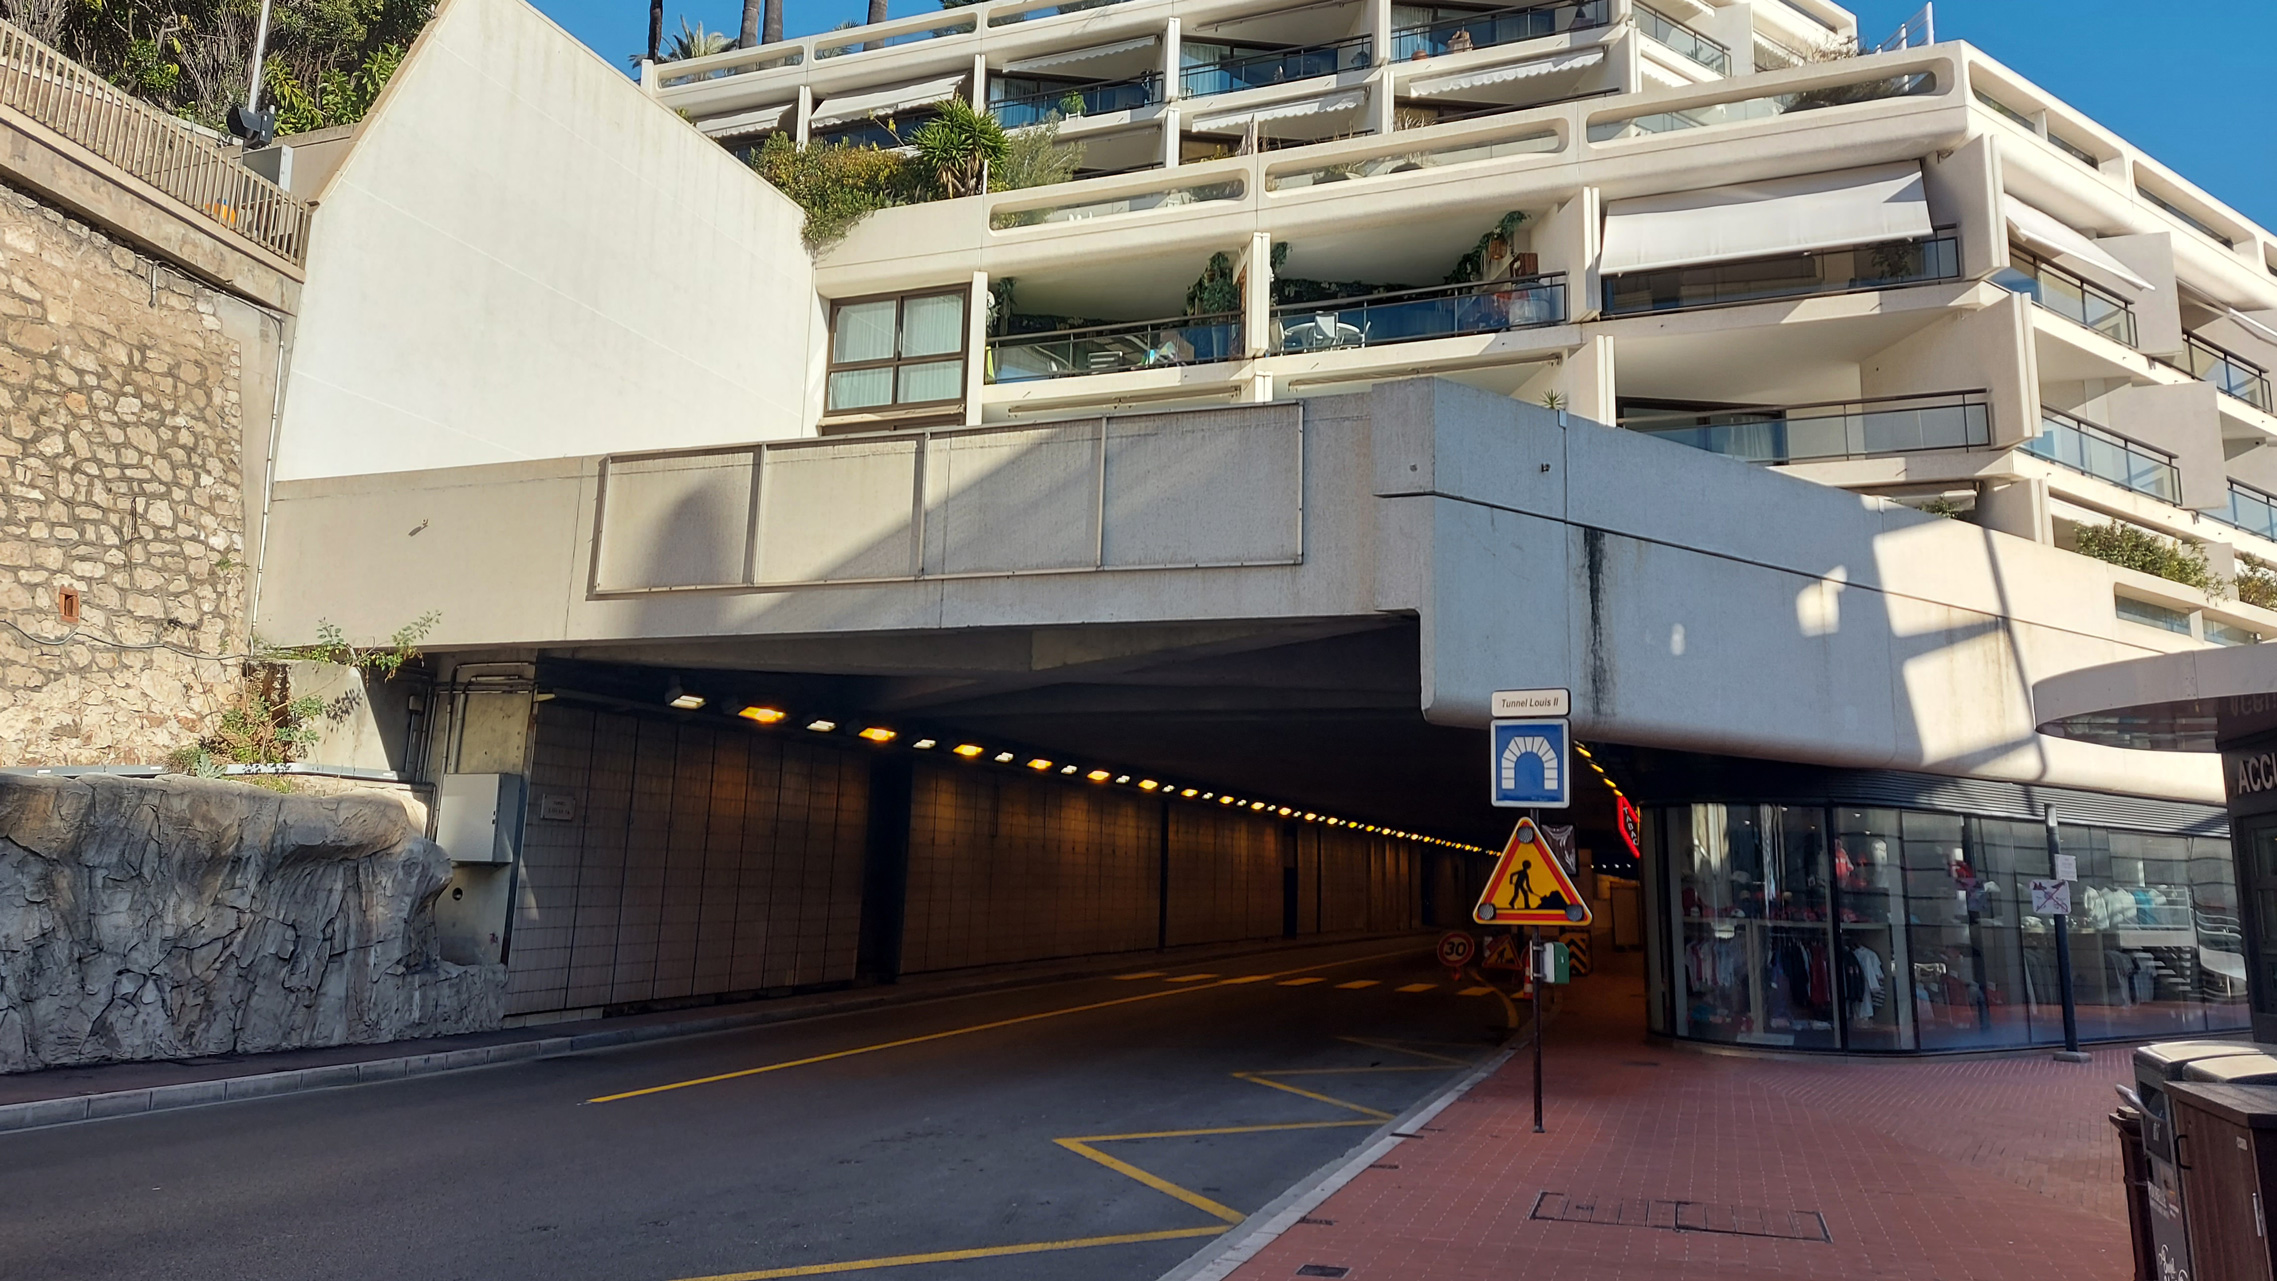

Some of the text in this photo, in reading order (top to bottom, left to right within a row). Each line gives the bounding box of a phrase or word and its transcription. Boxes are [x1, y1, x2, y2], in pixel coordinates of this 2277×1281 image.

[1502, 699, 1528, 708] Tunnel
[1529, 697, 1551, 708] Louis
[1623, 806, 1638, 845] TABAC
[1445, 941, 1467, 957] 30
